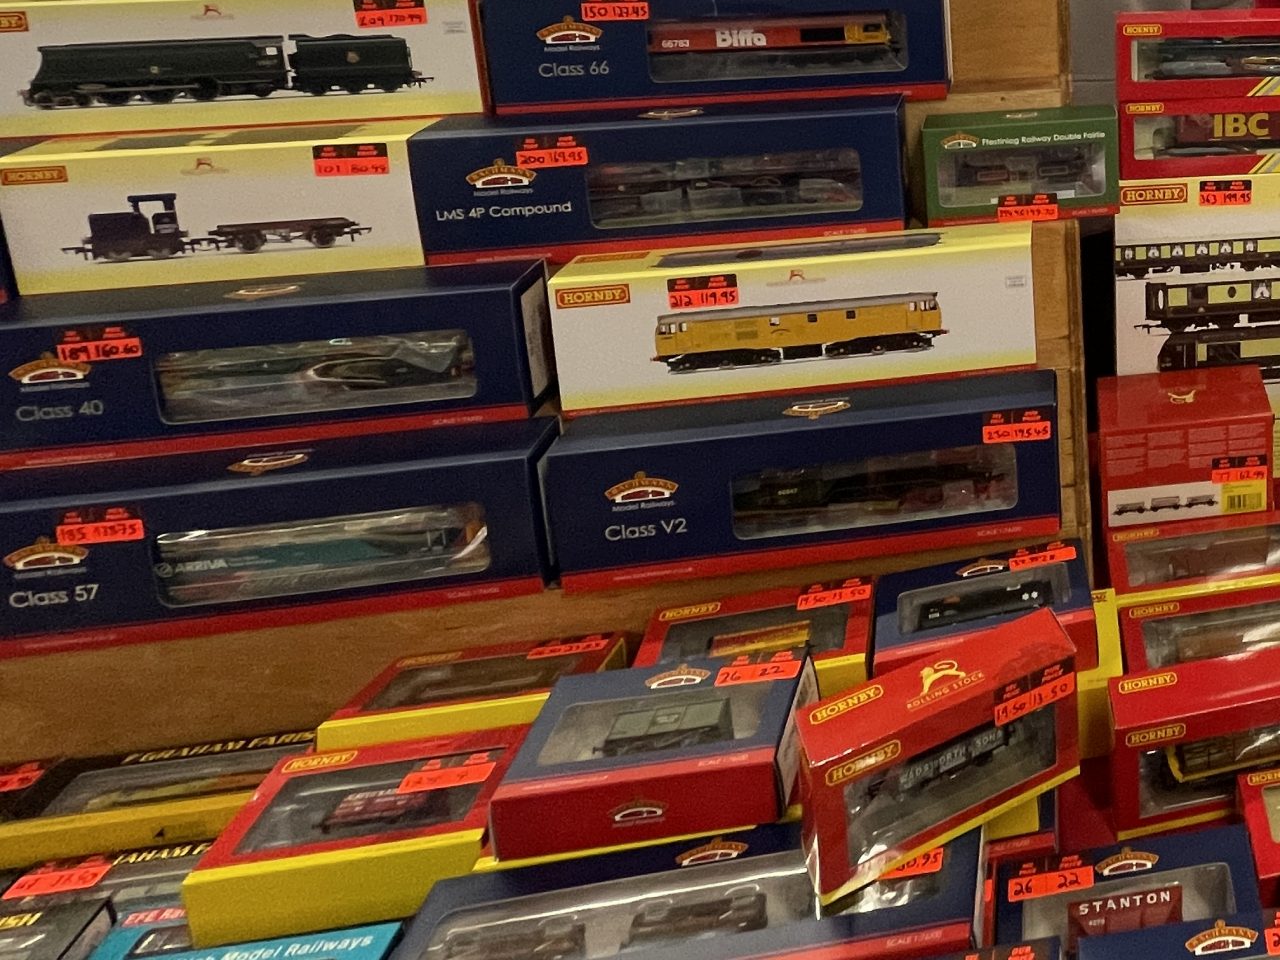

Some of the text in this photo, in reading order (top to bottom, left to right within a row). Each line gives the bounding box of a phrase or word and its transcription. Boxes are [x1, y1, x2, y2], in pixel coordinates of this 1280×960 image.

[583, 6, 608, 18] 150
[661, 28, 767, 48] 66783 Biffa
[1125, 24, 1160, 35] HORNBY
[538, 60, 610, 78] Class 66
[1128, 103, 1161, 113] HORNBY
[1212, 112, 1270, 139] IBC
[1021, 134, 1051, 144] Railway
[1053, 132, 1081, 142] Double
[519, 154, 545, 165] 200
[7, 168, 61, 184] HORNBY
[1126, 188, 1180, 203] HORNBY
[436, 201, 572, 221] LMS 4P Compound
[562, 289, 624, 307] HORNBY
[670, 294, 692, 307] 212
[15, 400, 104, 422] Class 40
[604, 518, 688, 541] Class V2
[174, 557, 228, 572] ARRIVA
[8, 582, 100, 609] Class 57
[664, 603, 716, 620] HORNBY
[1133, 603, 1175, 617] HORNBY
[720, 666, 785, 682] 26 22
[1124, 673, 1173, 691] HORNBY
[906, 671, 985, 710] ROLLING STOCK
[815, 687, 878, 721] HORNBY
[1131, 725, 1182, 744] HORNBY
[139, 737, 248, 762] GRAHAM
[289, 752, 351, 770] HORNBY
[1013, 872, 1081, 896] 26 22
[1079, 891, 1172, 916] STANTON
[126, 909, 156, 926] EFE
[221, 947, 281, 960] Model
[287, 934, 375, 957] Railways
